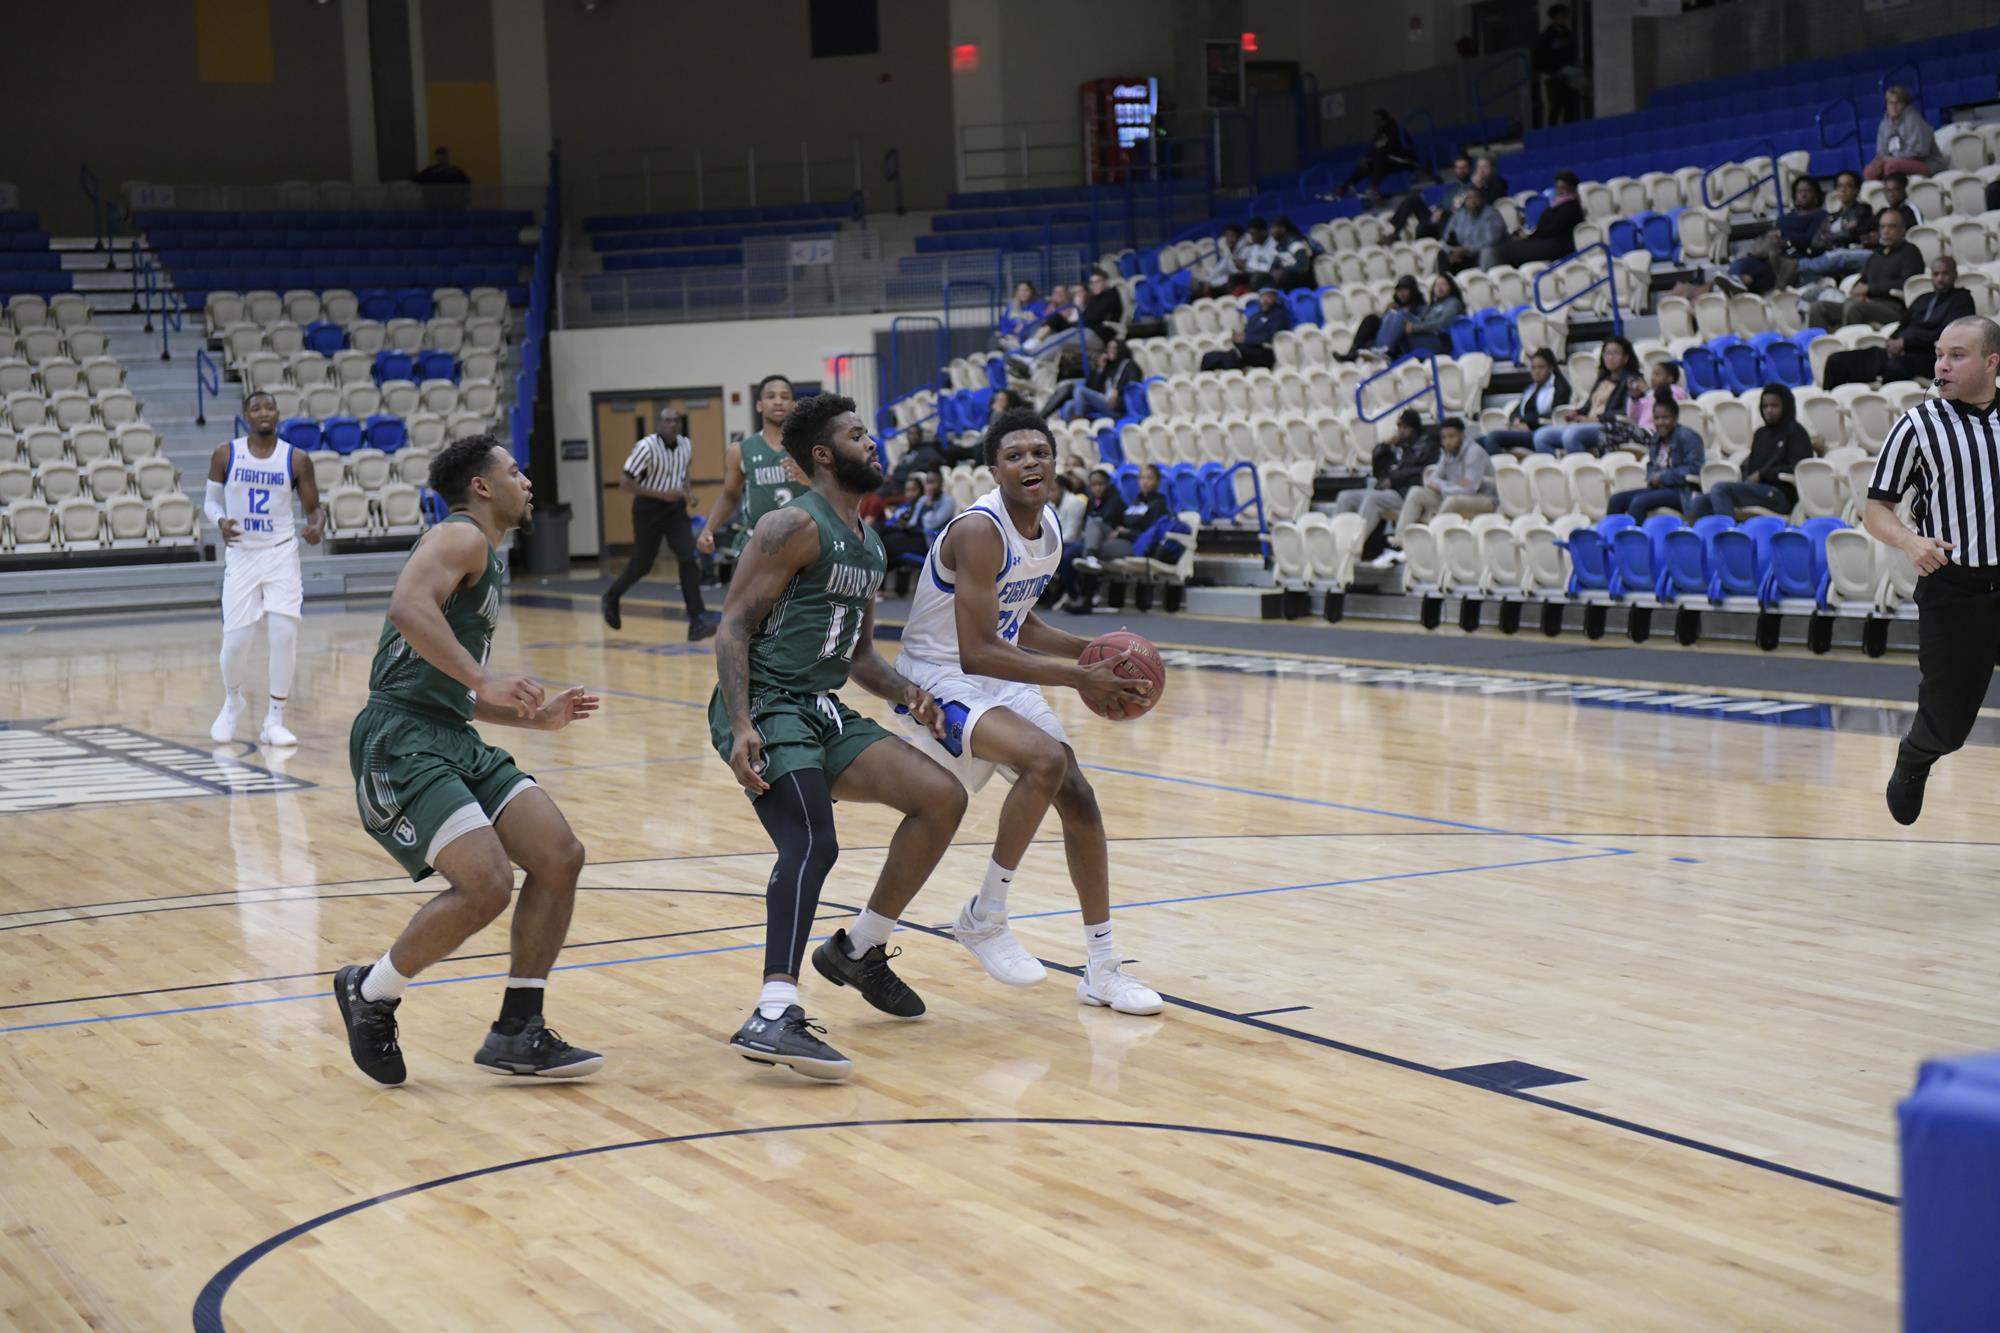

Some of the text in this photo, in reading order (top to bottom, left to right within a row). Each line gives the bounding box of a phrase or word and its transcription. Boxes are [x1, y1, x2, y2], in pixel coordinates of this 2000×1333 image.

[234, 467, 285, 486] FIGHTING
[248, 487, 270, 514] 12
[244, 518, 274, 532] OWLS
[817, 600, 865, 662] 11
